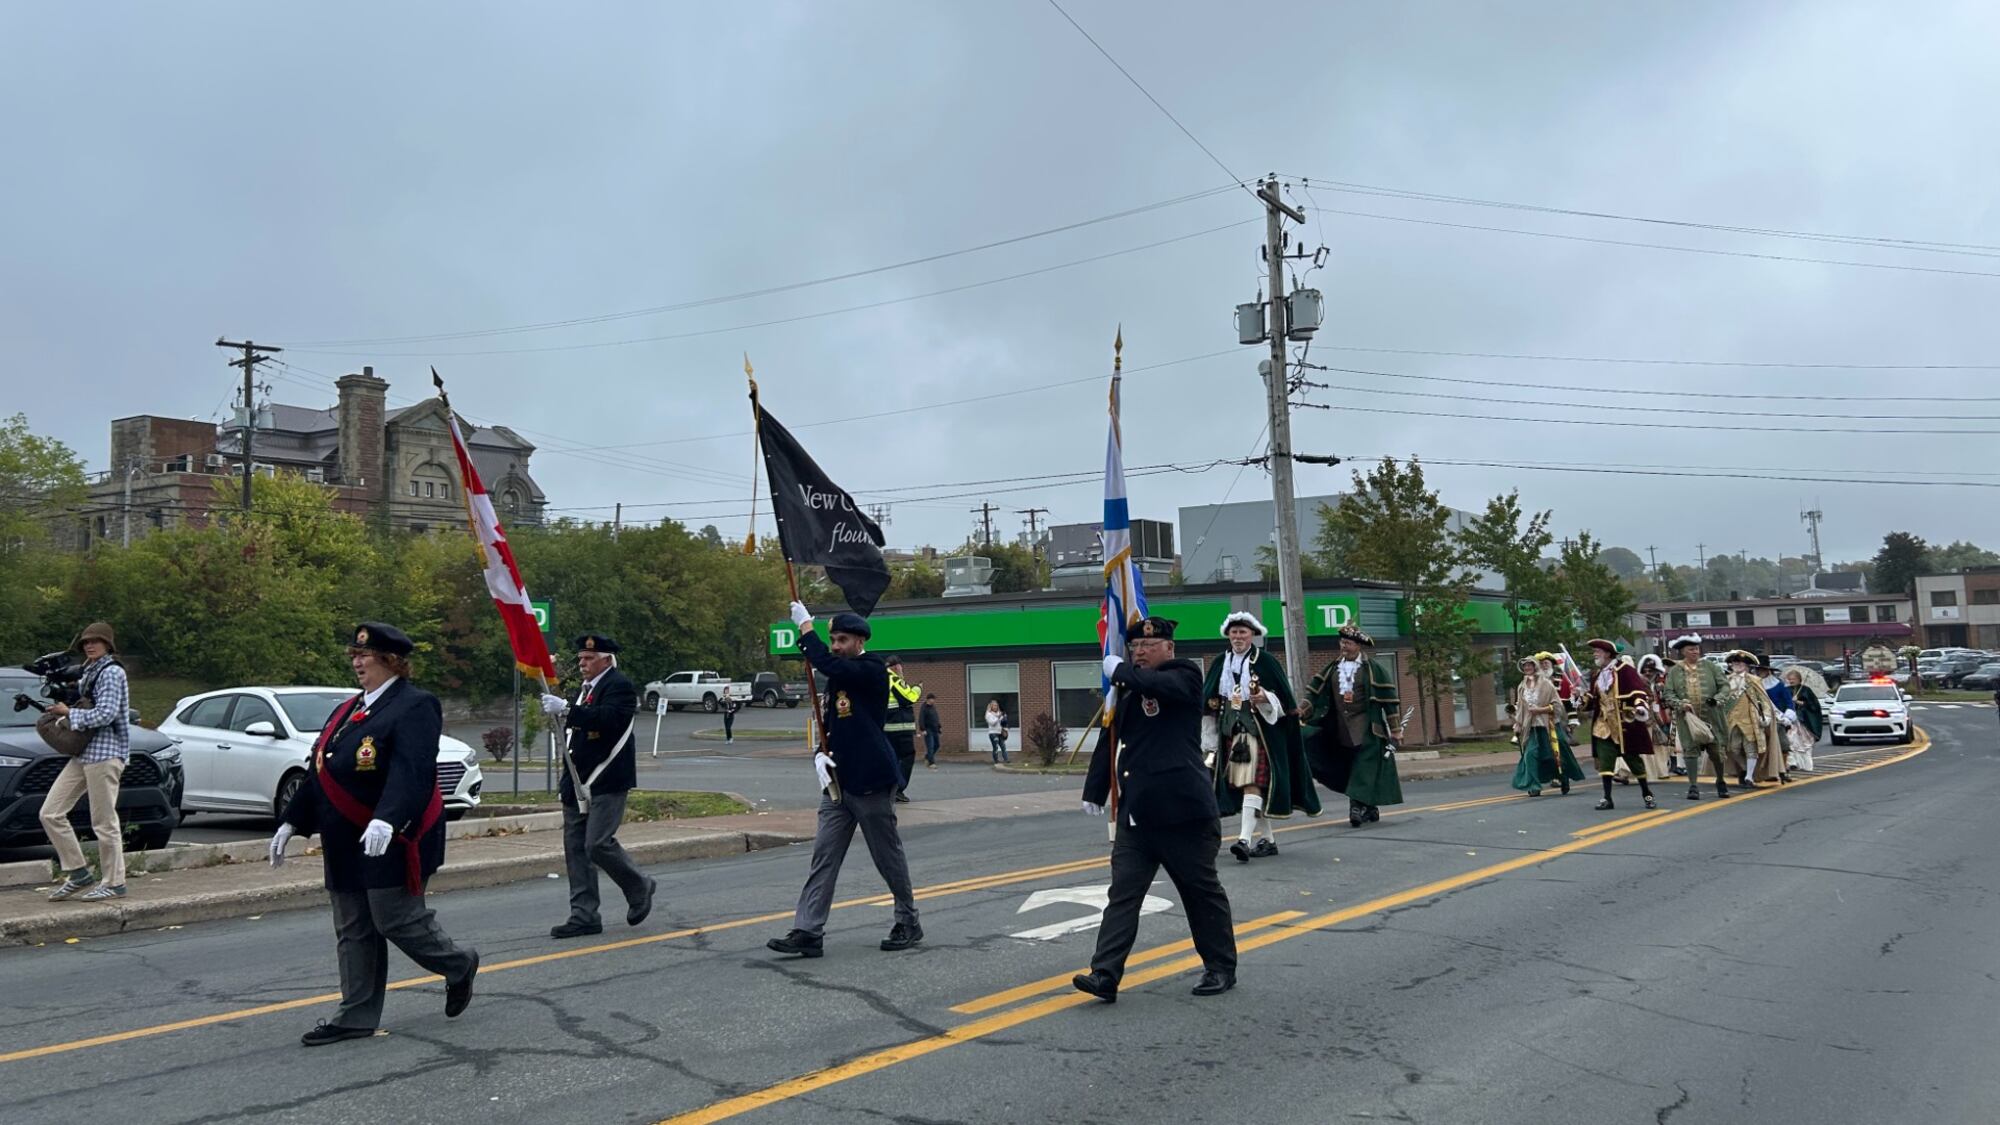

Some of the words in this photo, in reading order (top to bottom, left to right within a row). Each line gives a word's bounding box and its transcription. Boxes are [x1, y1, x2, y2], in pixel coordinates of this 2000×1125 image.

[798, 483, 838, 510] New
[1316, 604, 1352, 628] TD
[772, 628, 795, 649] TD
